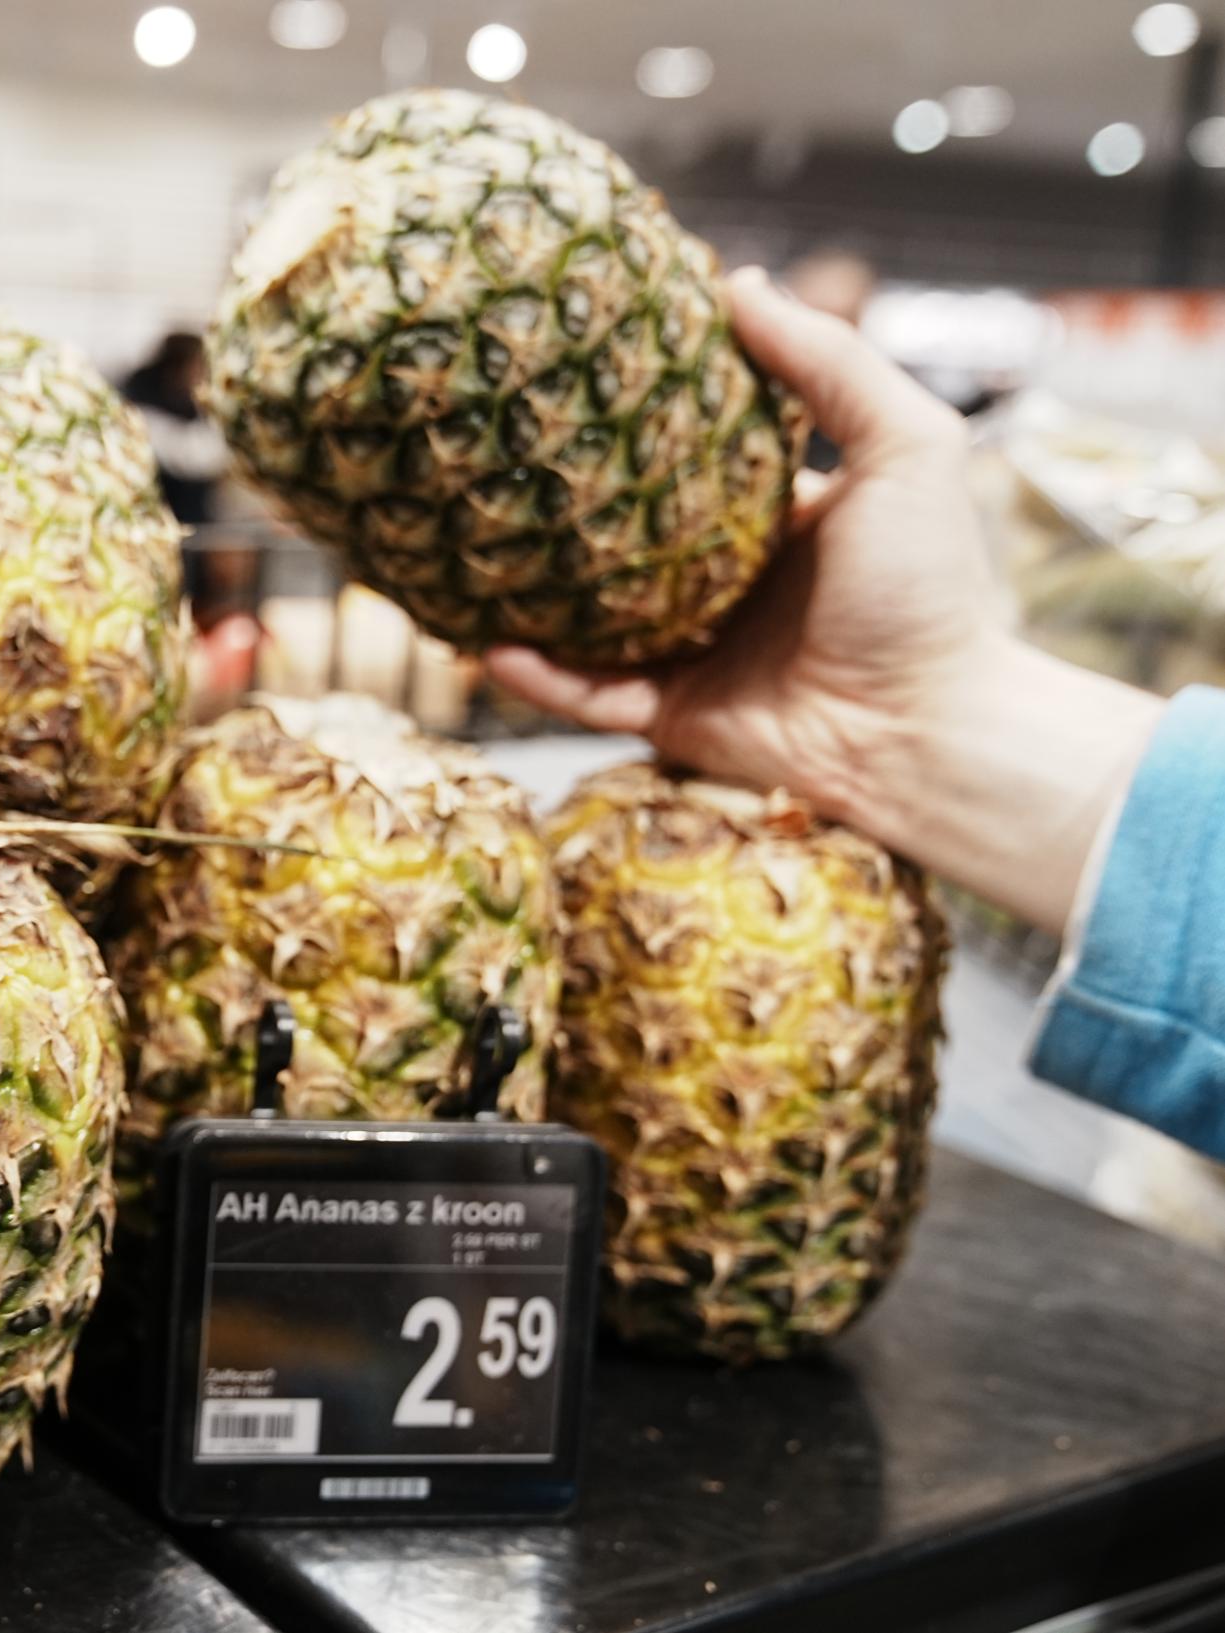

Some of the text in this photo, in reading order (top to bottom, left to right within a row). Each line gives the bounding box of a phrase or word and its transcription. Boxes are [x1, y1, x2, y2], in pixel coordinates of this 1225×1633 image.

[216, 1192, 525, 1225] AH Ananas z kroon
[478, 1296, 557, 1378] 59
